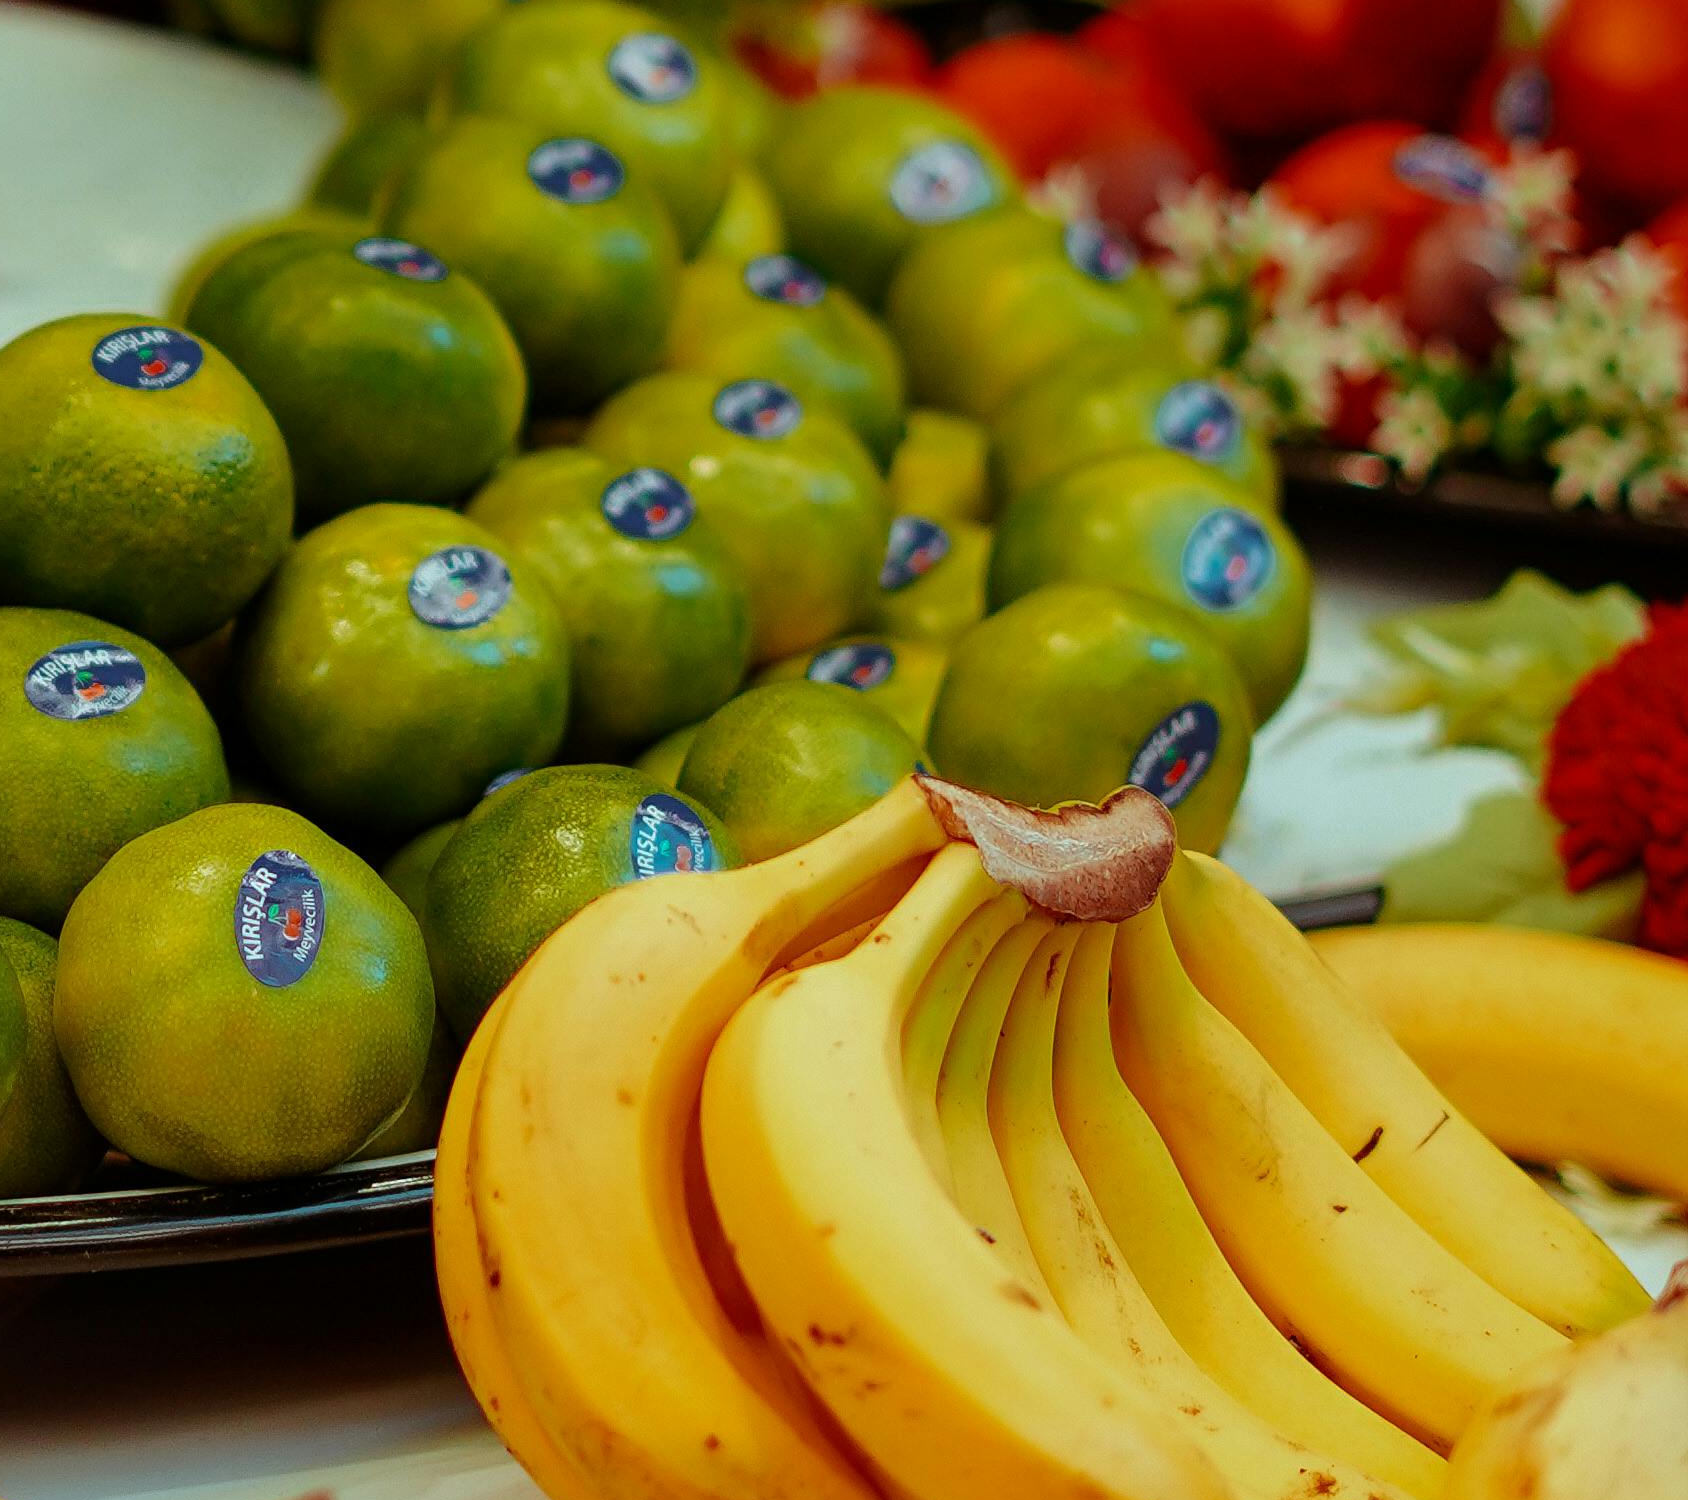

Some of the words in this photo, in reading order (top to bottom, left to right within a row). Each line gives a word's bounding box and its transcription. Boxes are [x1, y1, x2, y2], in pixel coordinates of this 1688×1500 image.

[97, 330, 170, 362] KIRIŞLAR
[34, 649, 113, 686] KIRIŞLAR
[635, 804, 666, 880] IRIŞLAR
[245, 866, 279, 961] KIRIŞLAR
[293, 888, 316, 962] Meyvecilik
